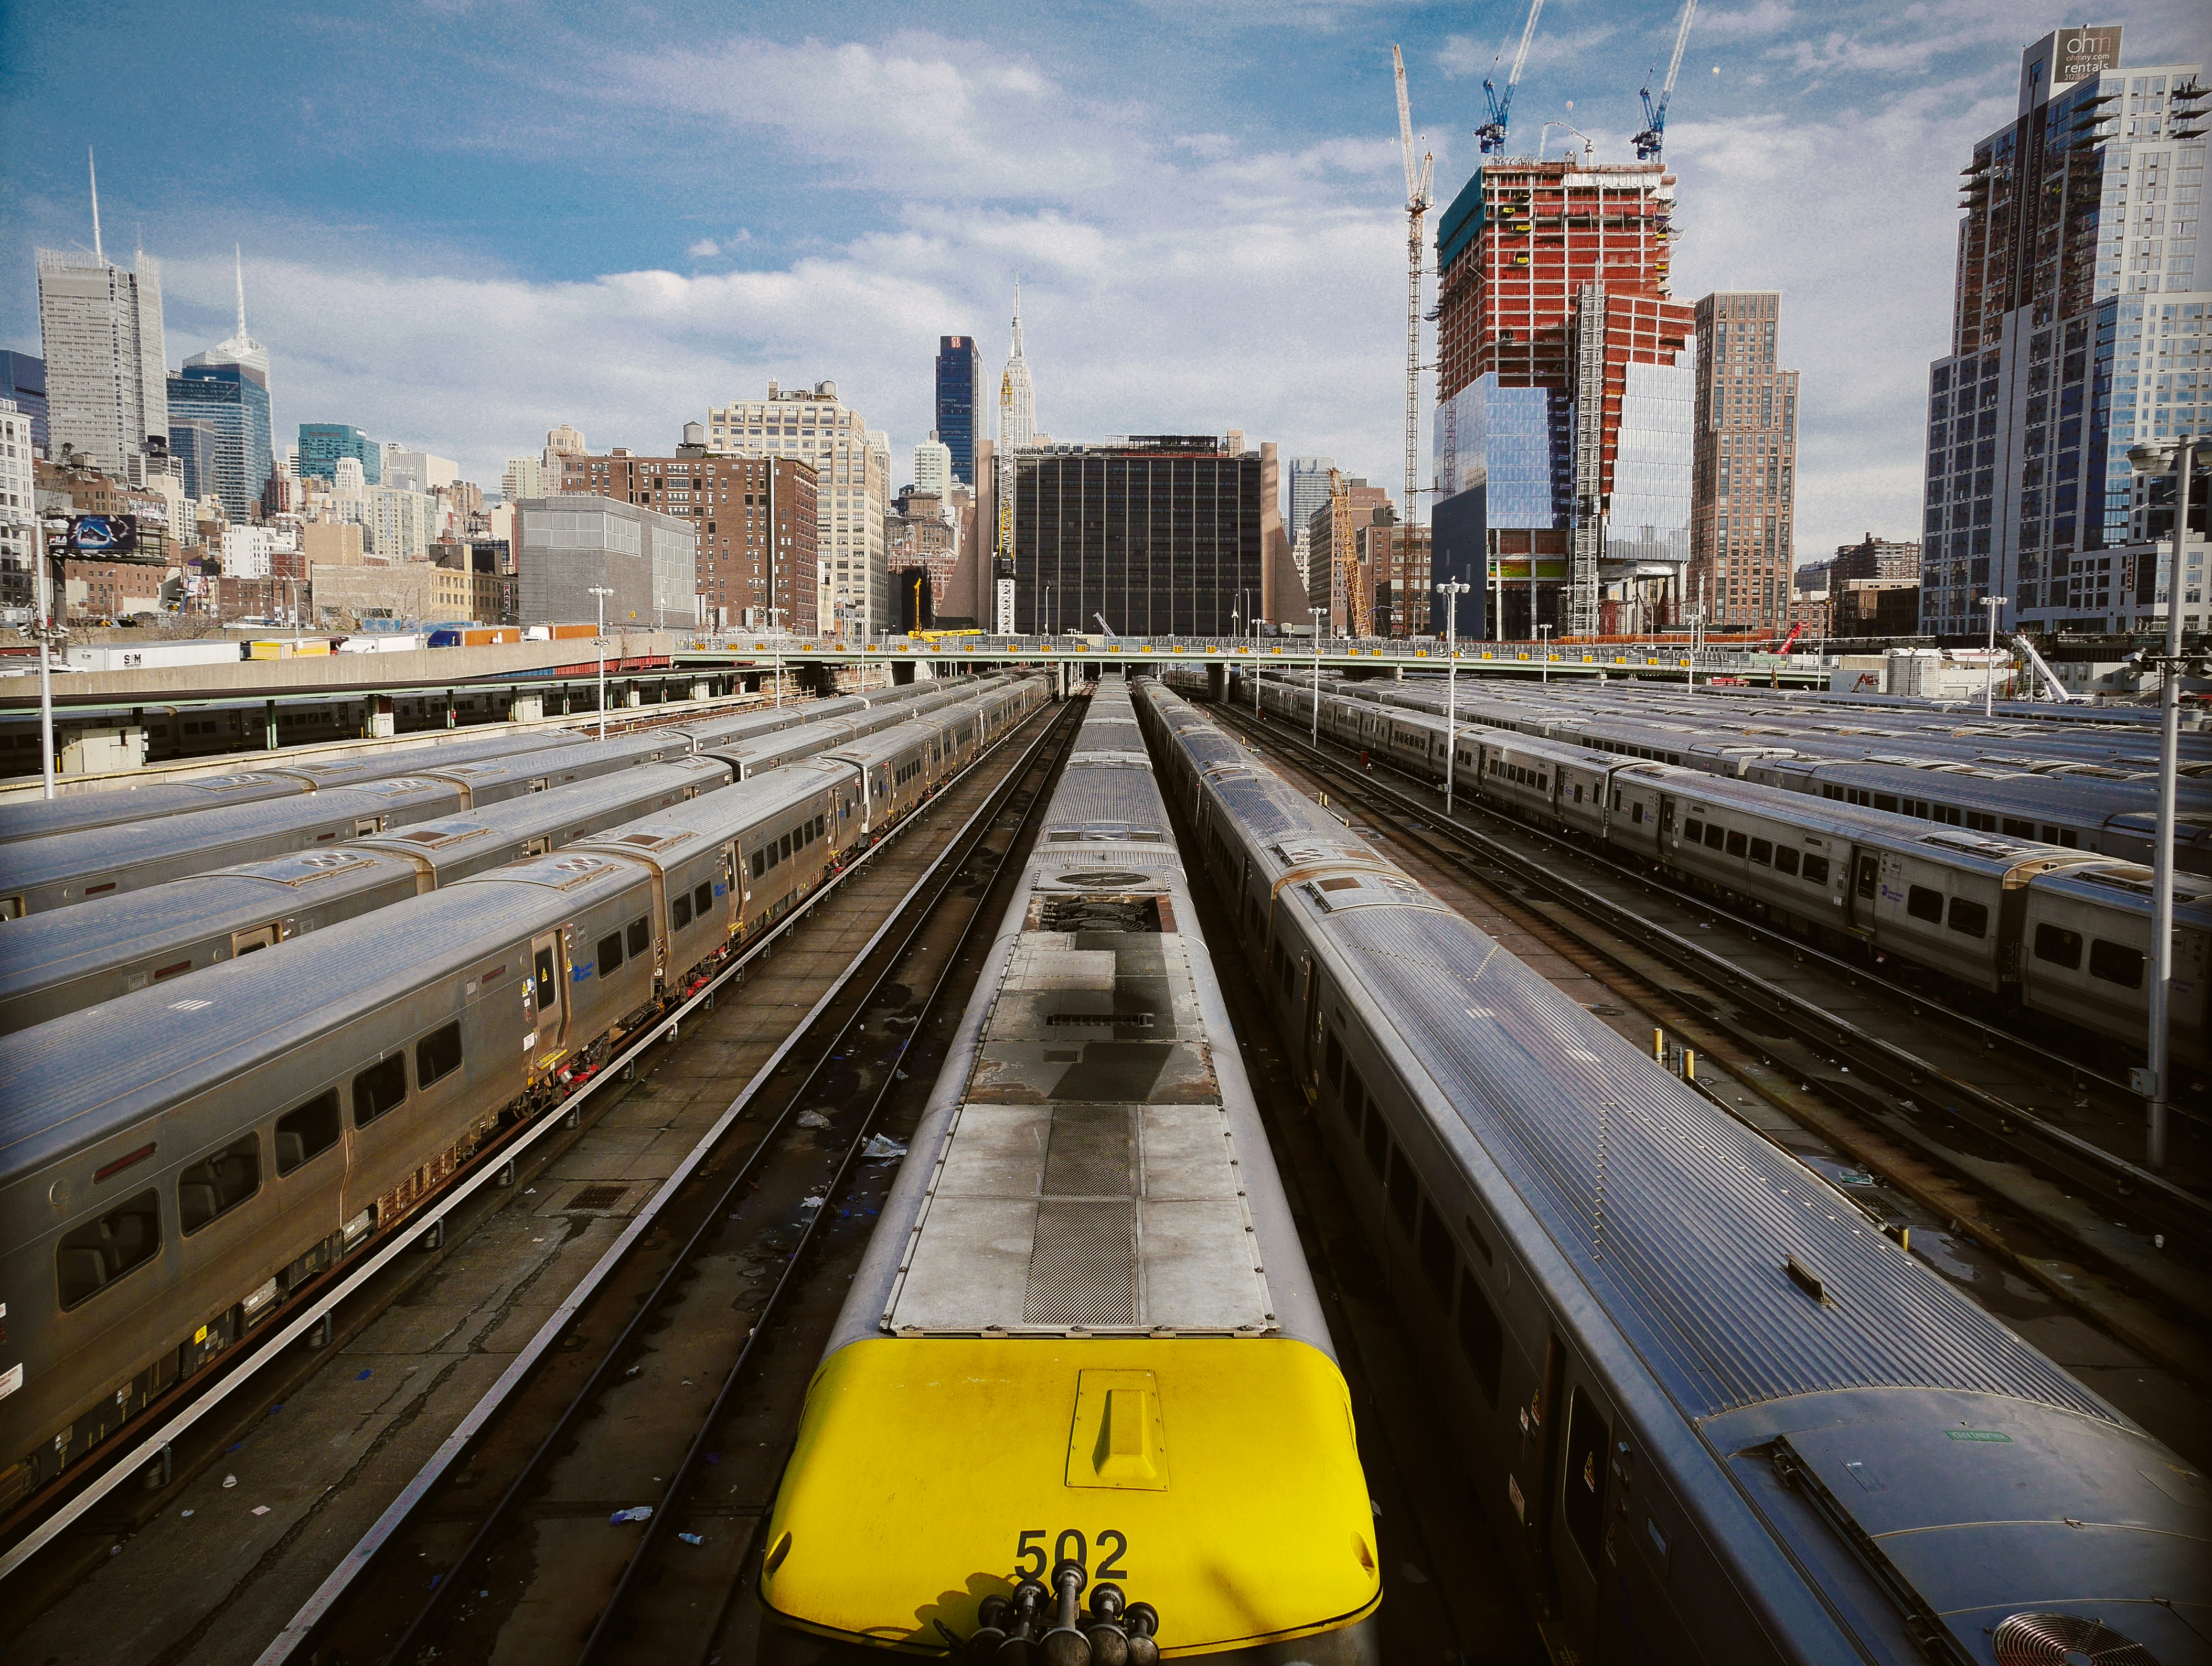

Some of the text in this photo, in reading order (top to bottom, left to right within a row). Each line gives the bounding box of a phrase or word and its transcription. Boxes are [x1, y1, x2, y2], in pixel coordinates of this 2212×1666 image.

[2067, 31, 2111, 53] ohm
[2065, 60, 2109, 73] rentals
[2066, 54, 2110, 62] ohmny.com
[2032, 133, 2041, 172] there's
[2031, 176, 2037, 191] no
[2027, 195, 2037, 226] place
[124, 654, 141, 664] S&M
[1014, 1529, 1127, 1580] 502
